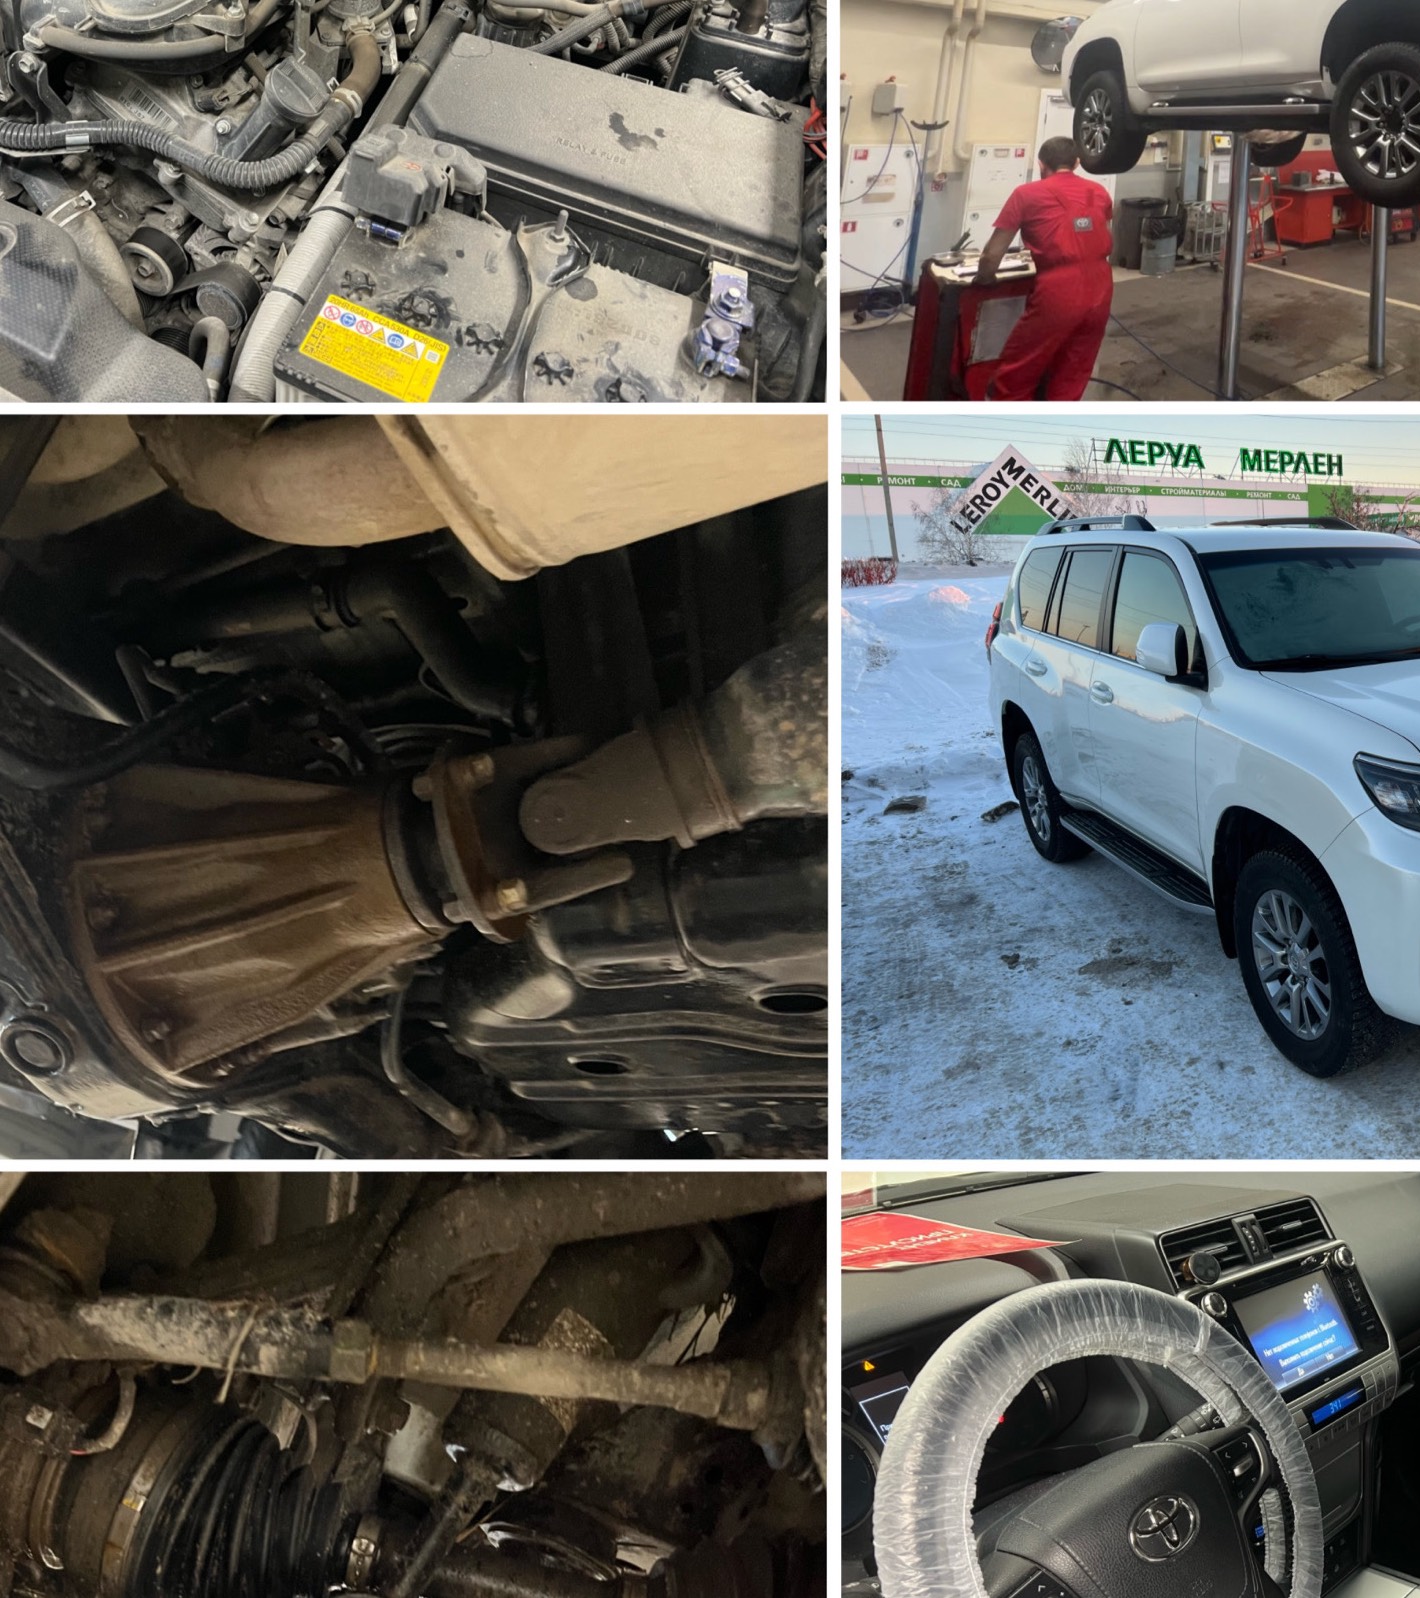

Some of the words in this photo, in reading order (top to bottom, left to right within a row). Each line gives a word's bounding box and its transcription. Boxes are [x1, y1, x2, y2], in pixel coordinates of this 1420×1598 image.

[1103, 437, 1205, 469] ЛЕРУА
[1240, 447, 1343, 476] МЕРЛЕН
[941, 479, 961, 488] САД
[950, 470, 1010, 535] LEROY
[1001, 456, 1078, 521] MERLI
[1161, 488, 1227, 497] СТРОЙМАТЕРИАЛЫ
